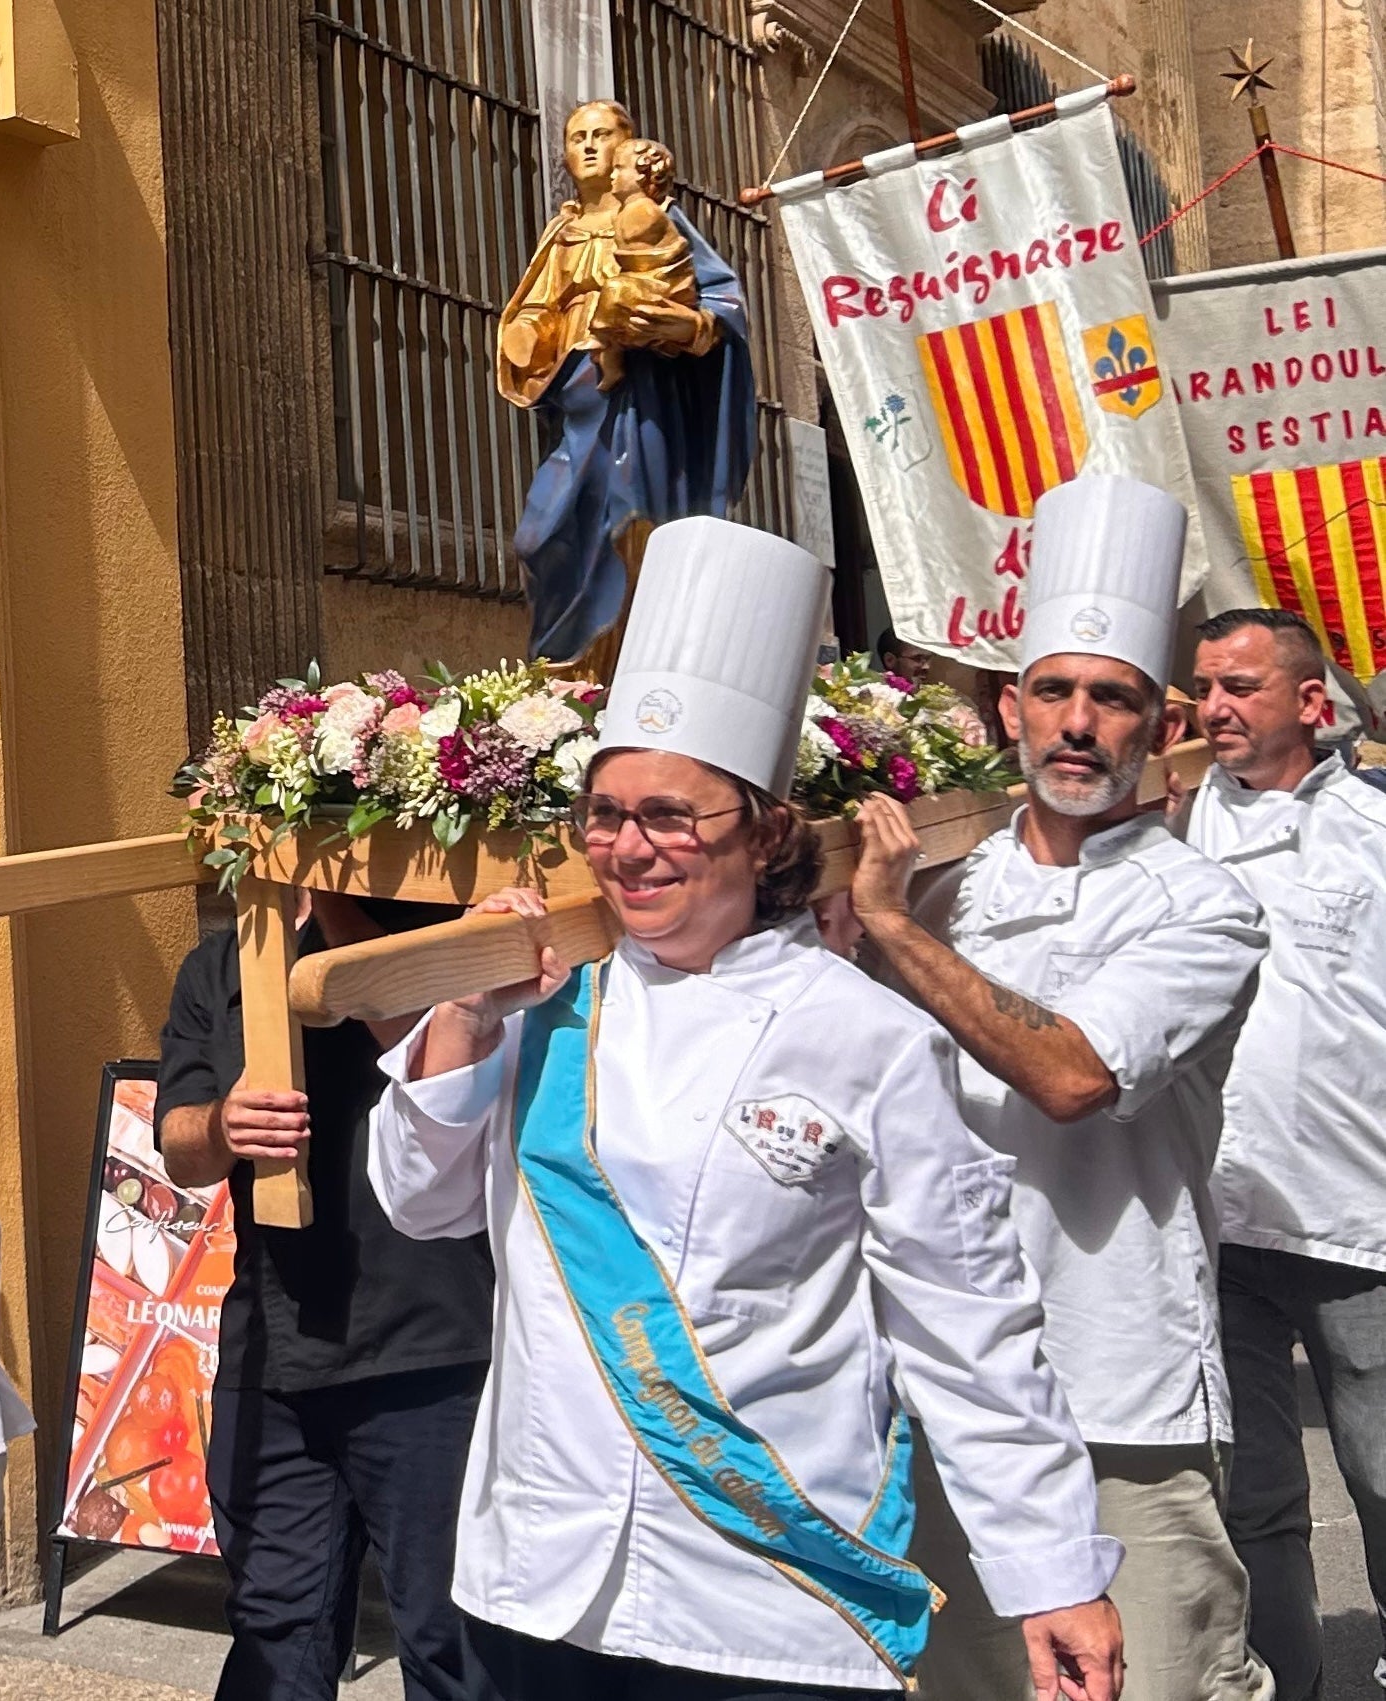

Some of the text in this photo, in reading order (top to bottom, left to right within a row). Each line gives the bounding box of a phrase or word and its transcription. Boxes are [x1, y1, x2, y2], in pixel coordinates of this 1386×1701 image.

[926, 176, 978, 233] Li
[1264, 296, 1336, 337] LEI
[1170, 345, 1386, 405] RANDOUL
[1226, 406, 1386, 455] SESTIA
[611, 1302, 700, 1437] Compagnon
[689, 1431, 729, 1467] du
